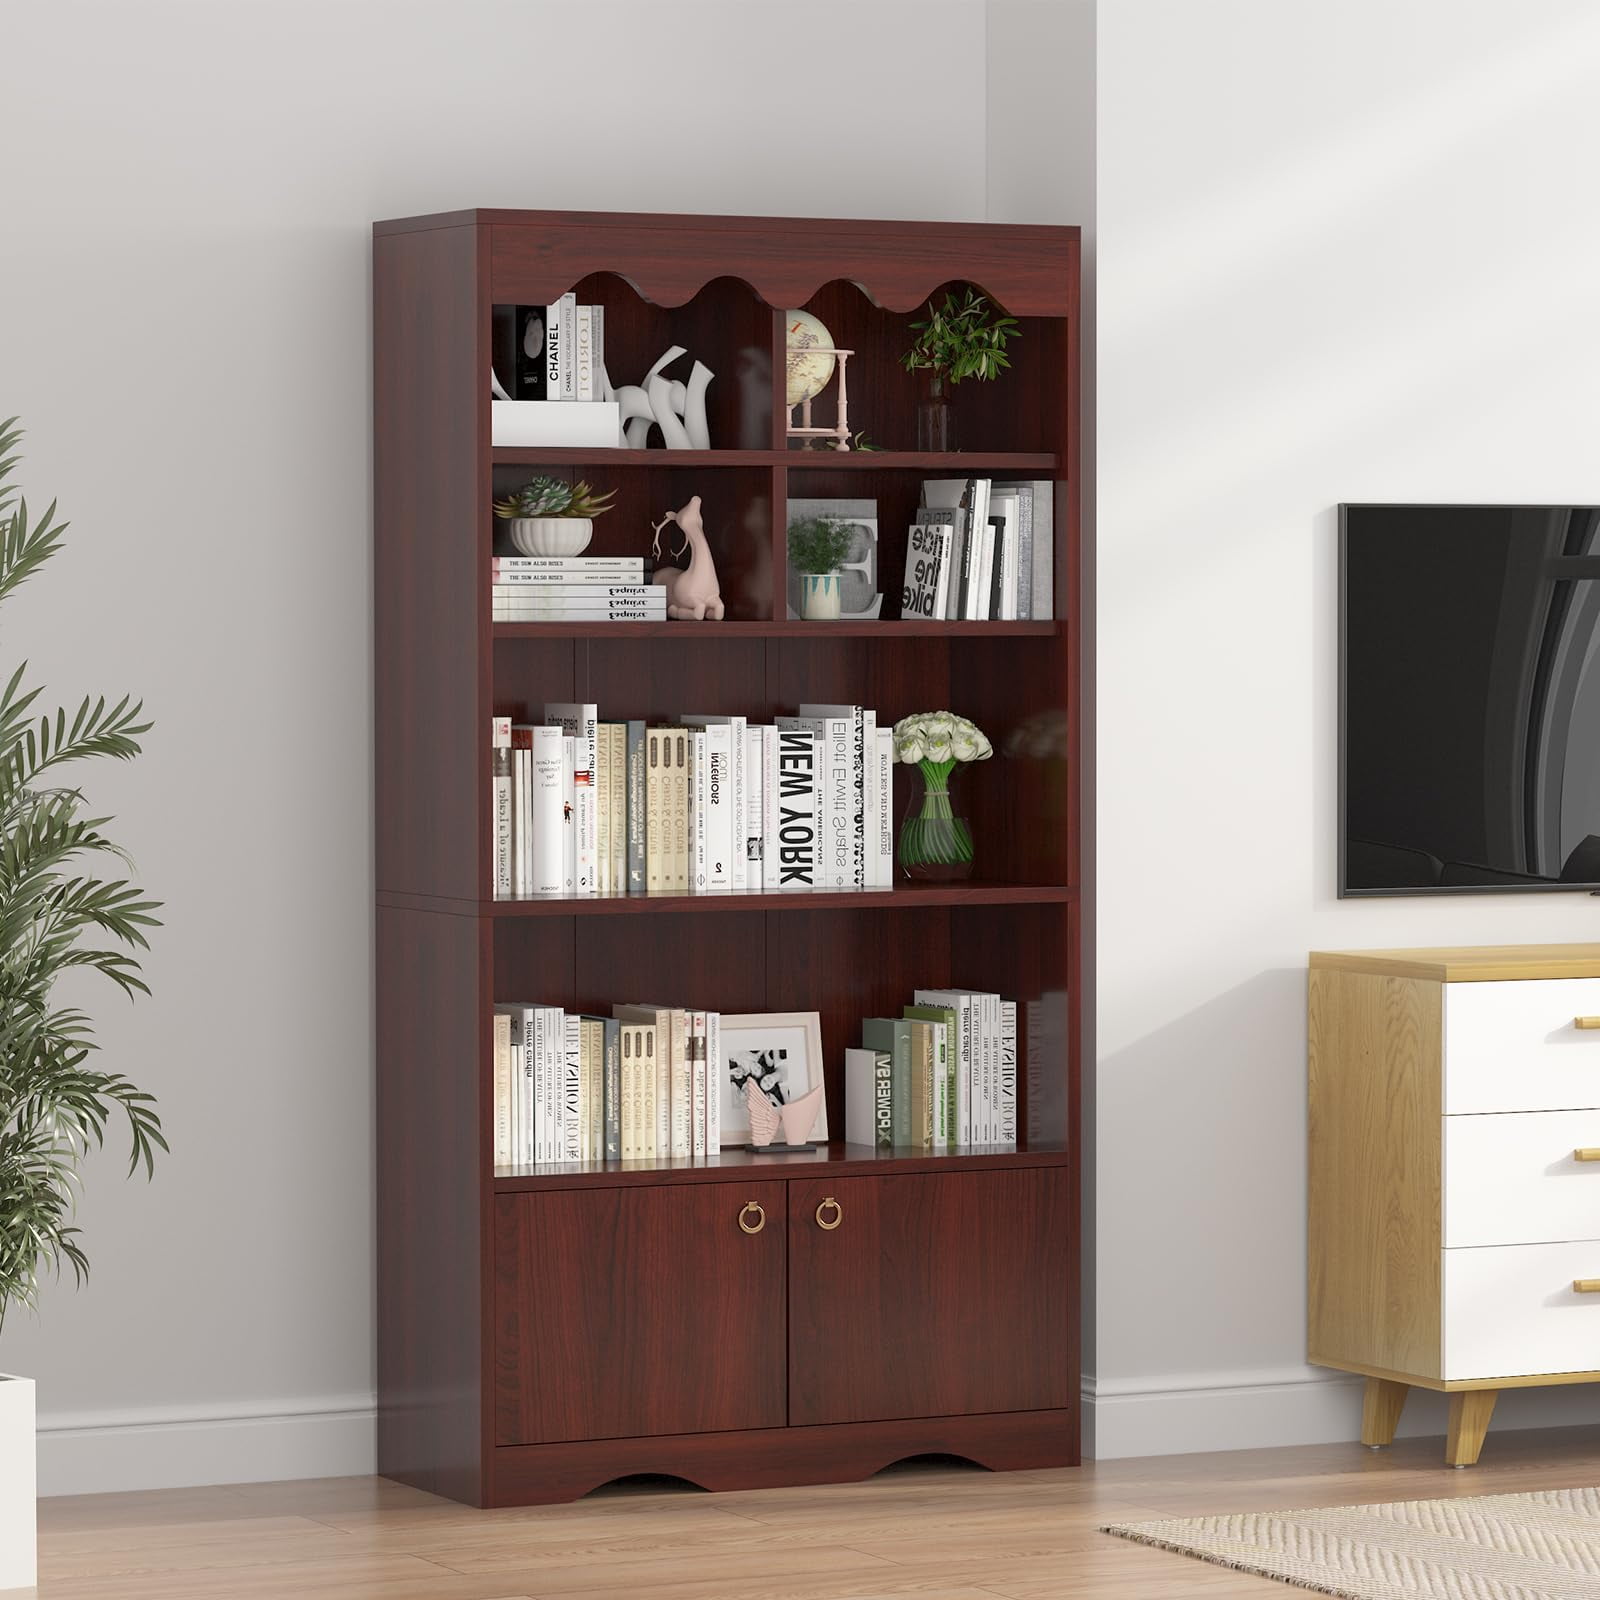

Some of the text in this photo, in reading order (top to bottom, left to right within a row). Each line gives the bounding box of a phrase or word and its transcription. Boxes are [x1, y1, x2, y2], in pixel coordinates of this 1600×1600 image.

[549, 324, 558, 381] CHANEL
[696, 1072, 705, 1094] Leader
[696, 1108, 705, 1117] of
